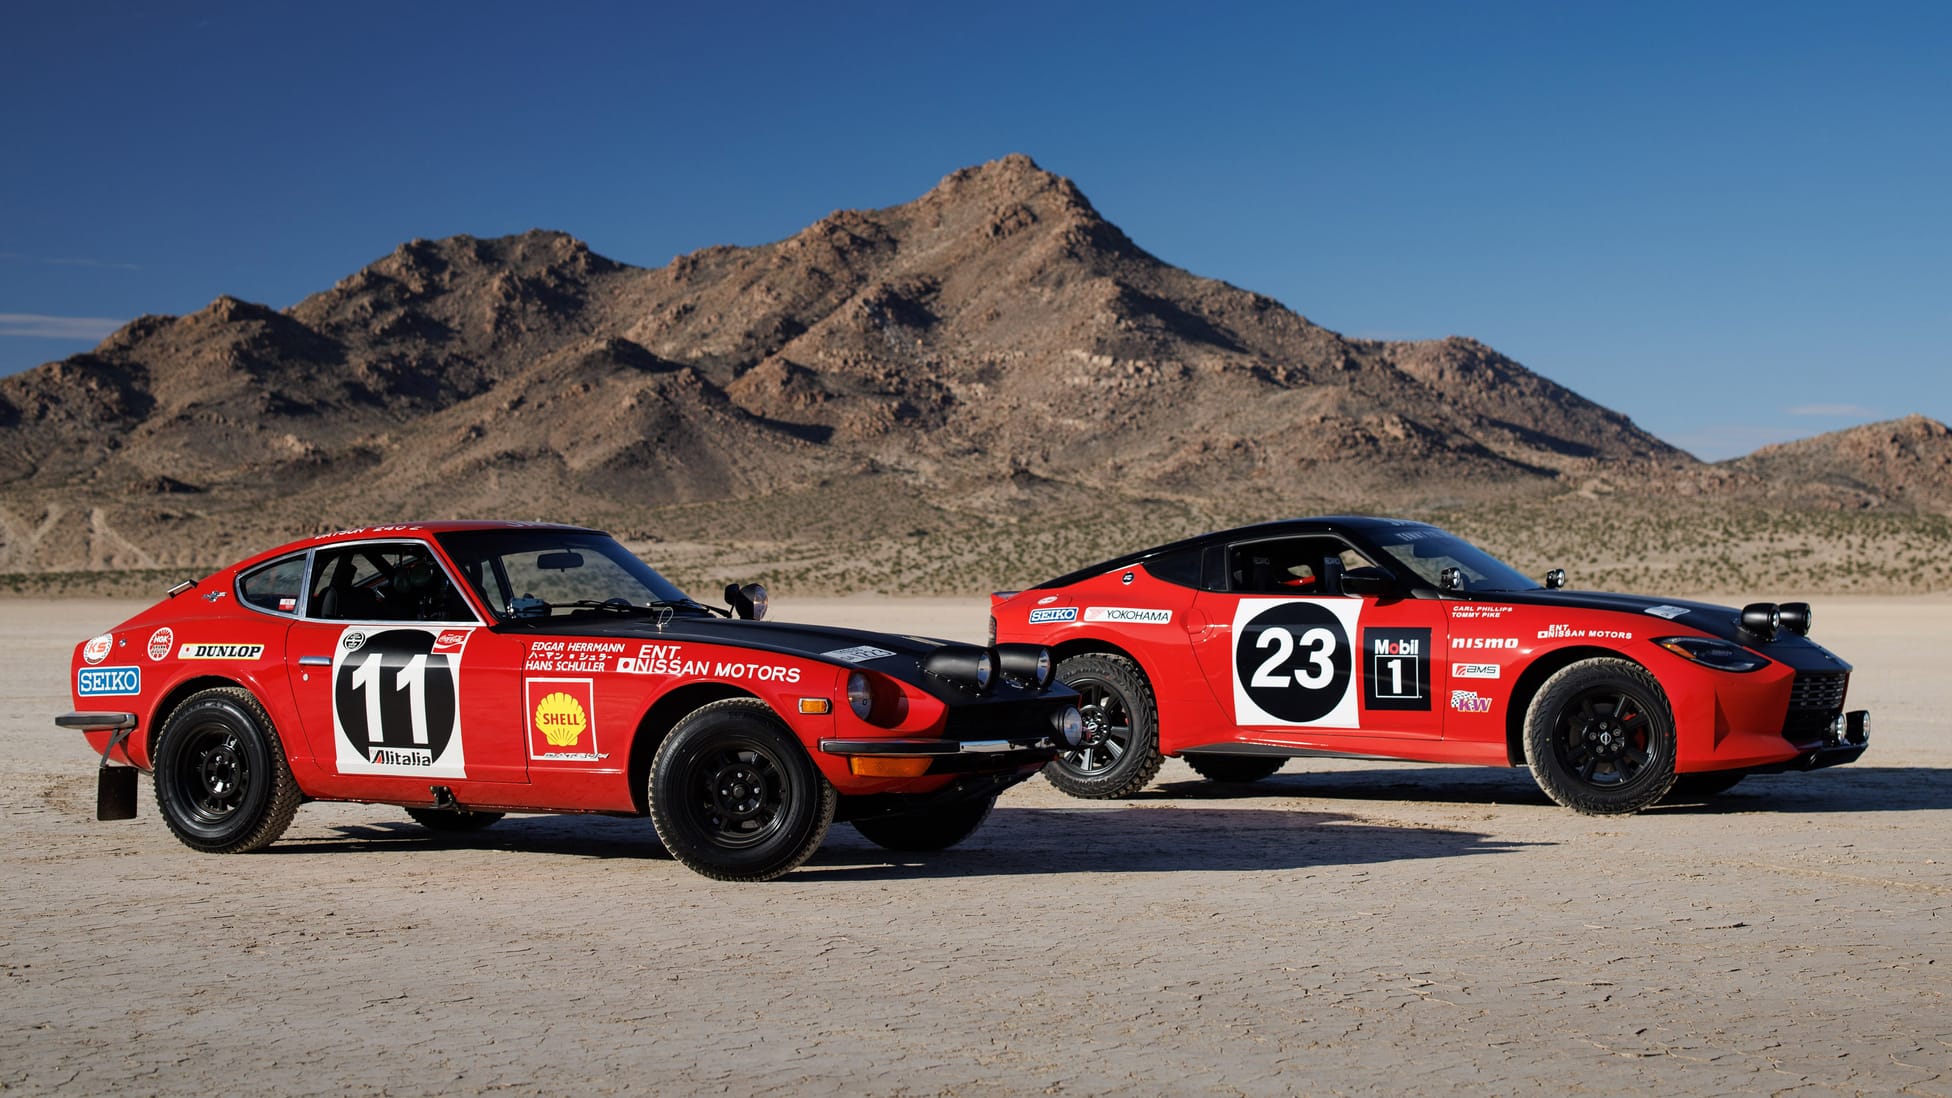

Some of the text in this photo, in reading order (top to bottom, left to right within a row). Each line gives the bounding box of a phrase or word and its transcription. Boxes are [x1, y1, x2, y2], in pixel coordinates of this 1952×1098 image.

[1031, 608, 1075, 620] SEIKO
[1106, 609, 1169, 621] YOKOHAMA
[1547, 630, 1633, 640] NISSAN MOTORS
[88, 642, 108, 653] KS
[194, 645, 262, 658] DUNLOP
[531, 641, 626, 653] EDGAR HERRMANN
[638, 644, 682, 660] ENT.
[1374, 639, 1419, 655] Mobil
[1250, 627, 1337, 690] 23
[525, 661, 606, 673] HANS SCHULLER
[635, 658, 801, 683] NISSAN MOTORS
[80, 670, 138, 692] SEIKO
[1387, 659, 1403, 694] 1
[352, 653, 429, 744] 11
[1458, 697, 1493, 713] KW
[543, 713, 580, 726] SHELL
[371, 750, 432, 767] Alitalia
